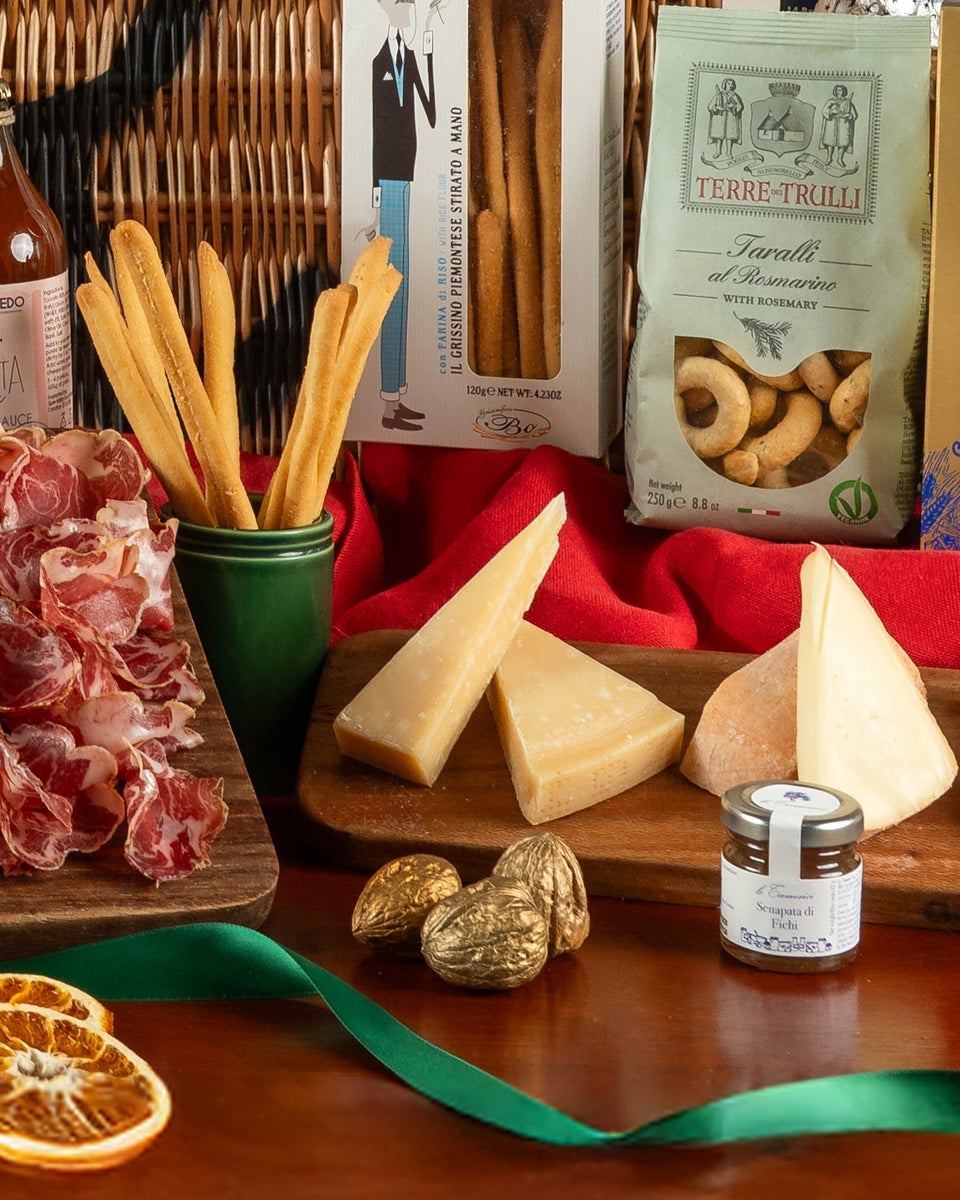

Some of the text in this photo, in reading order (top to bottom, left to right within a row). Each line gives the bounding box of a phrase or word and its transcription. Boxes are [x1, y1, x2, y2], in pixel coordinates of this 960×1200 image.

[695, 175, 771, 204] TERRE
[780, 181, 861, 210] TRULLI
[451, 107, 462, 375] IL GRISSINO PIEMONTESE STIRATO A MANO
[726, 233, 821, 264] Taralli
[438, 257, 447, 285] RISO
[708, 264, 837, 292] al Rosmarino
[723, 293, 818, 310] WITH ROSEMARY
[438, 306, 447, 349] FARINA
[467, 385, 486, 397] 120g
[497, 387, 513, 397] NET
[649, 479, 682, 492] Net weight
[692, 497, 708, 510] 8.8
[711, 502, 720, 511] oz
[756, 901, 814, 918] Senapata di
[772, 918, 798, 931] Fichi
